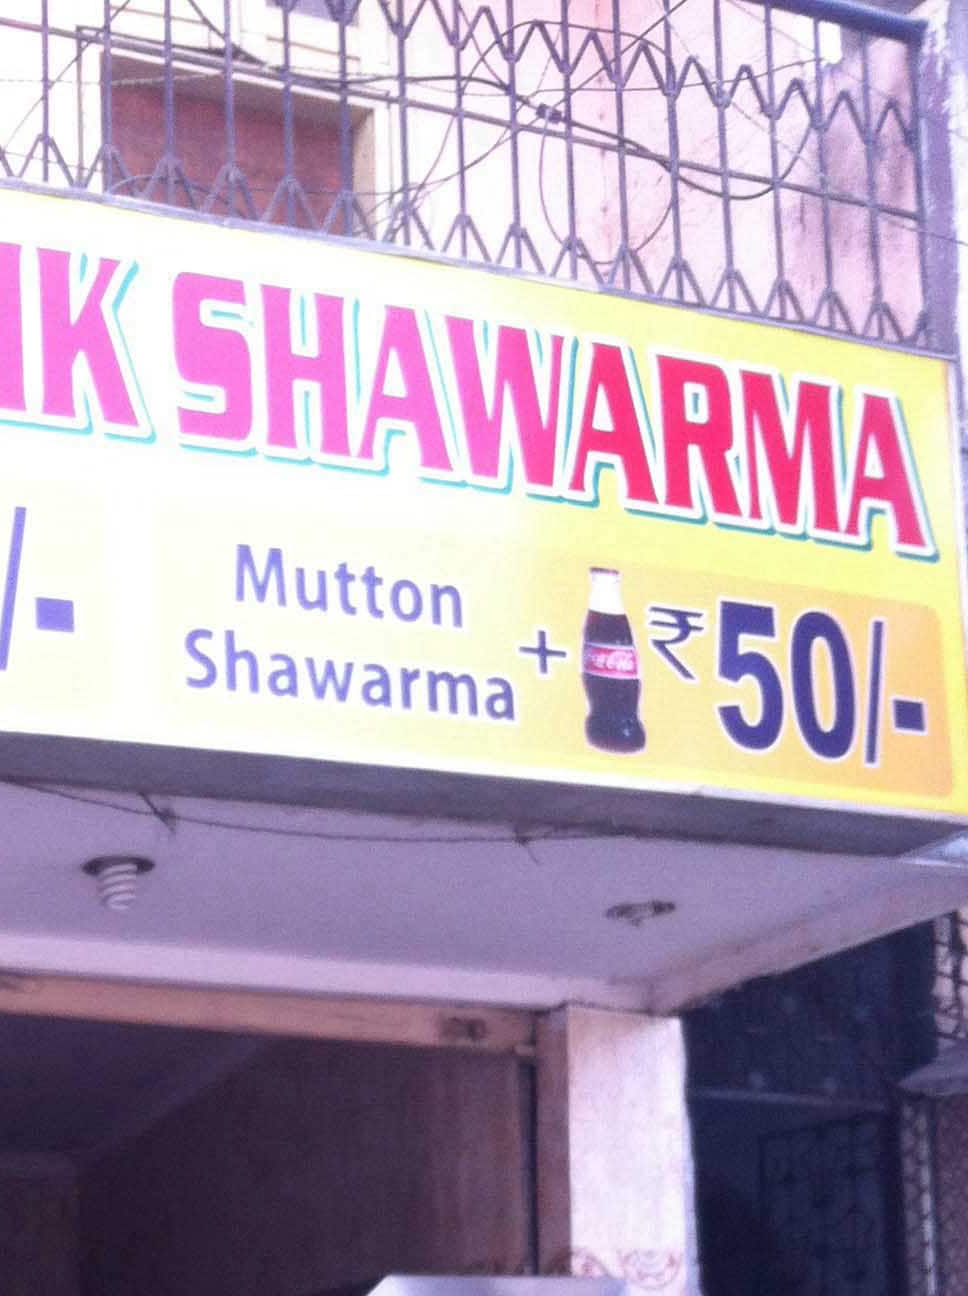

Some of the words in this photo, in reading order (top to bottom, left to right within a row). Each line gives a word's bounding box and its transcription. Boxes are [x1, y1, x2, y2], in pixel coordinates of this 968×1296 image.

[171, 270, 929, 549] SHAWARMA
[234, 544, 464, 628] Mutton
[183, 629, 517, 721] Shawarma
